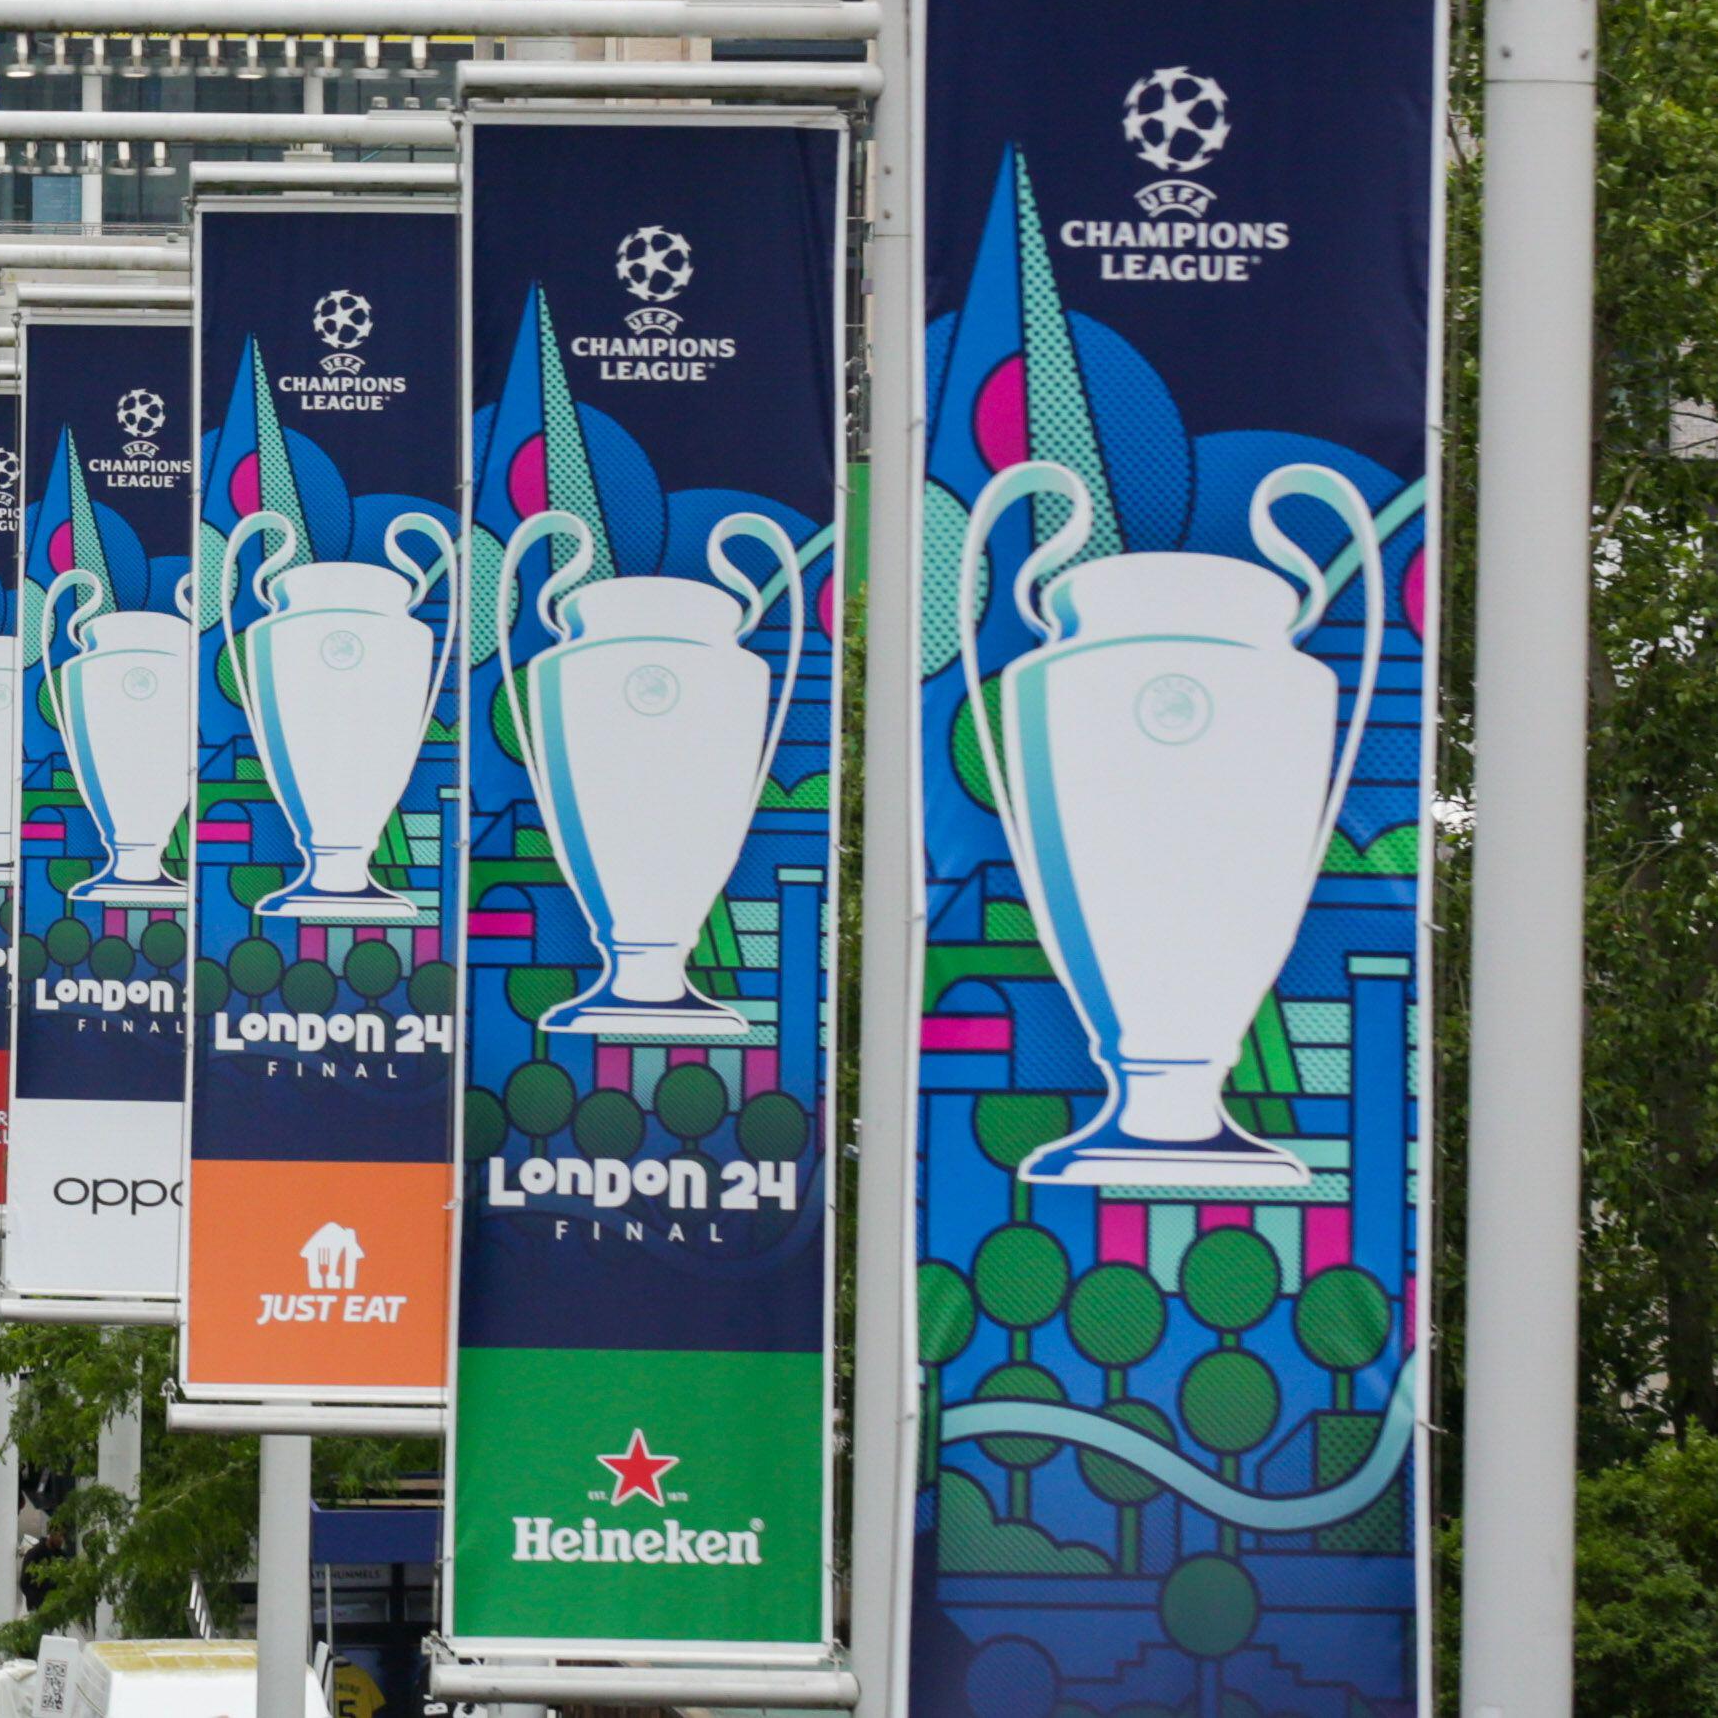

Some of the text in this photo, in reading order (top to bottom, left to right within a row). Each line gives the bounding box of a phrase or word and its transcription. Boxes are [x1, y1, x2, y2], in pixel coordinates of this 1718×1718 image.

[1137, 186, 1215, 214] UEFA
[1060, 220, 1289, 250] CHAMPIONS
[1101, 252, 1249, 281] LEAGUE
[627, 312, 680, 335] UEFA
[571, 337, 735, 359] CHAMPIONS
[321, 356, 361, 374] UEFA
[600, 360, 707, 381] LEAGUE
[278, 376, 406, 394] CHAMPIONS
[300, 394, 384, 412] LEAGUE
[89, 459, 192, 473] CHAMPIONS
[107, 475, 174, 488] LEAGUE
[78, 1018, 184, 1034] FINAL
[395, 1014, 452, 1054] 24
[267, 1061, 398, 1079] FINAL
[721, 1162, 797, 1211] 24
[556, 1221, 722, 1243] FINAL
[256, 1294, 406, 1325] JUST EAT
[512, 1516, 761, 1566] Heineken
